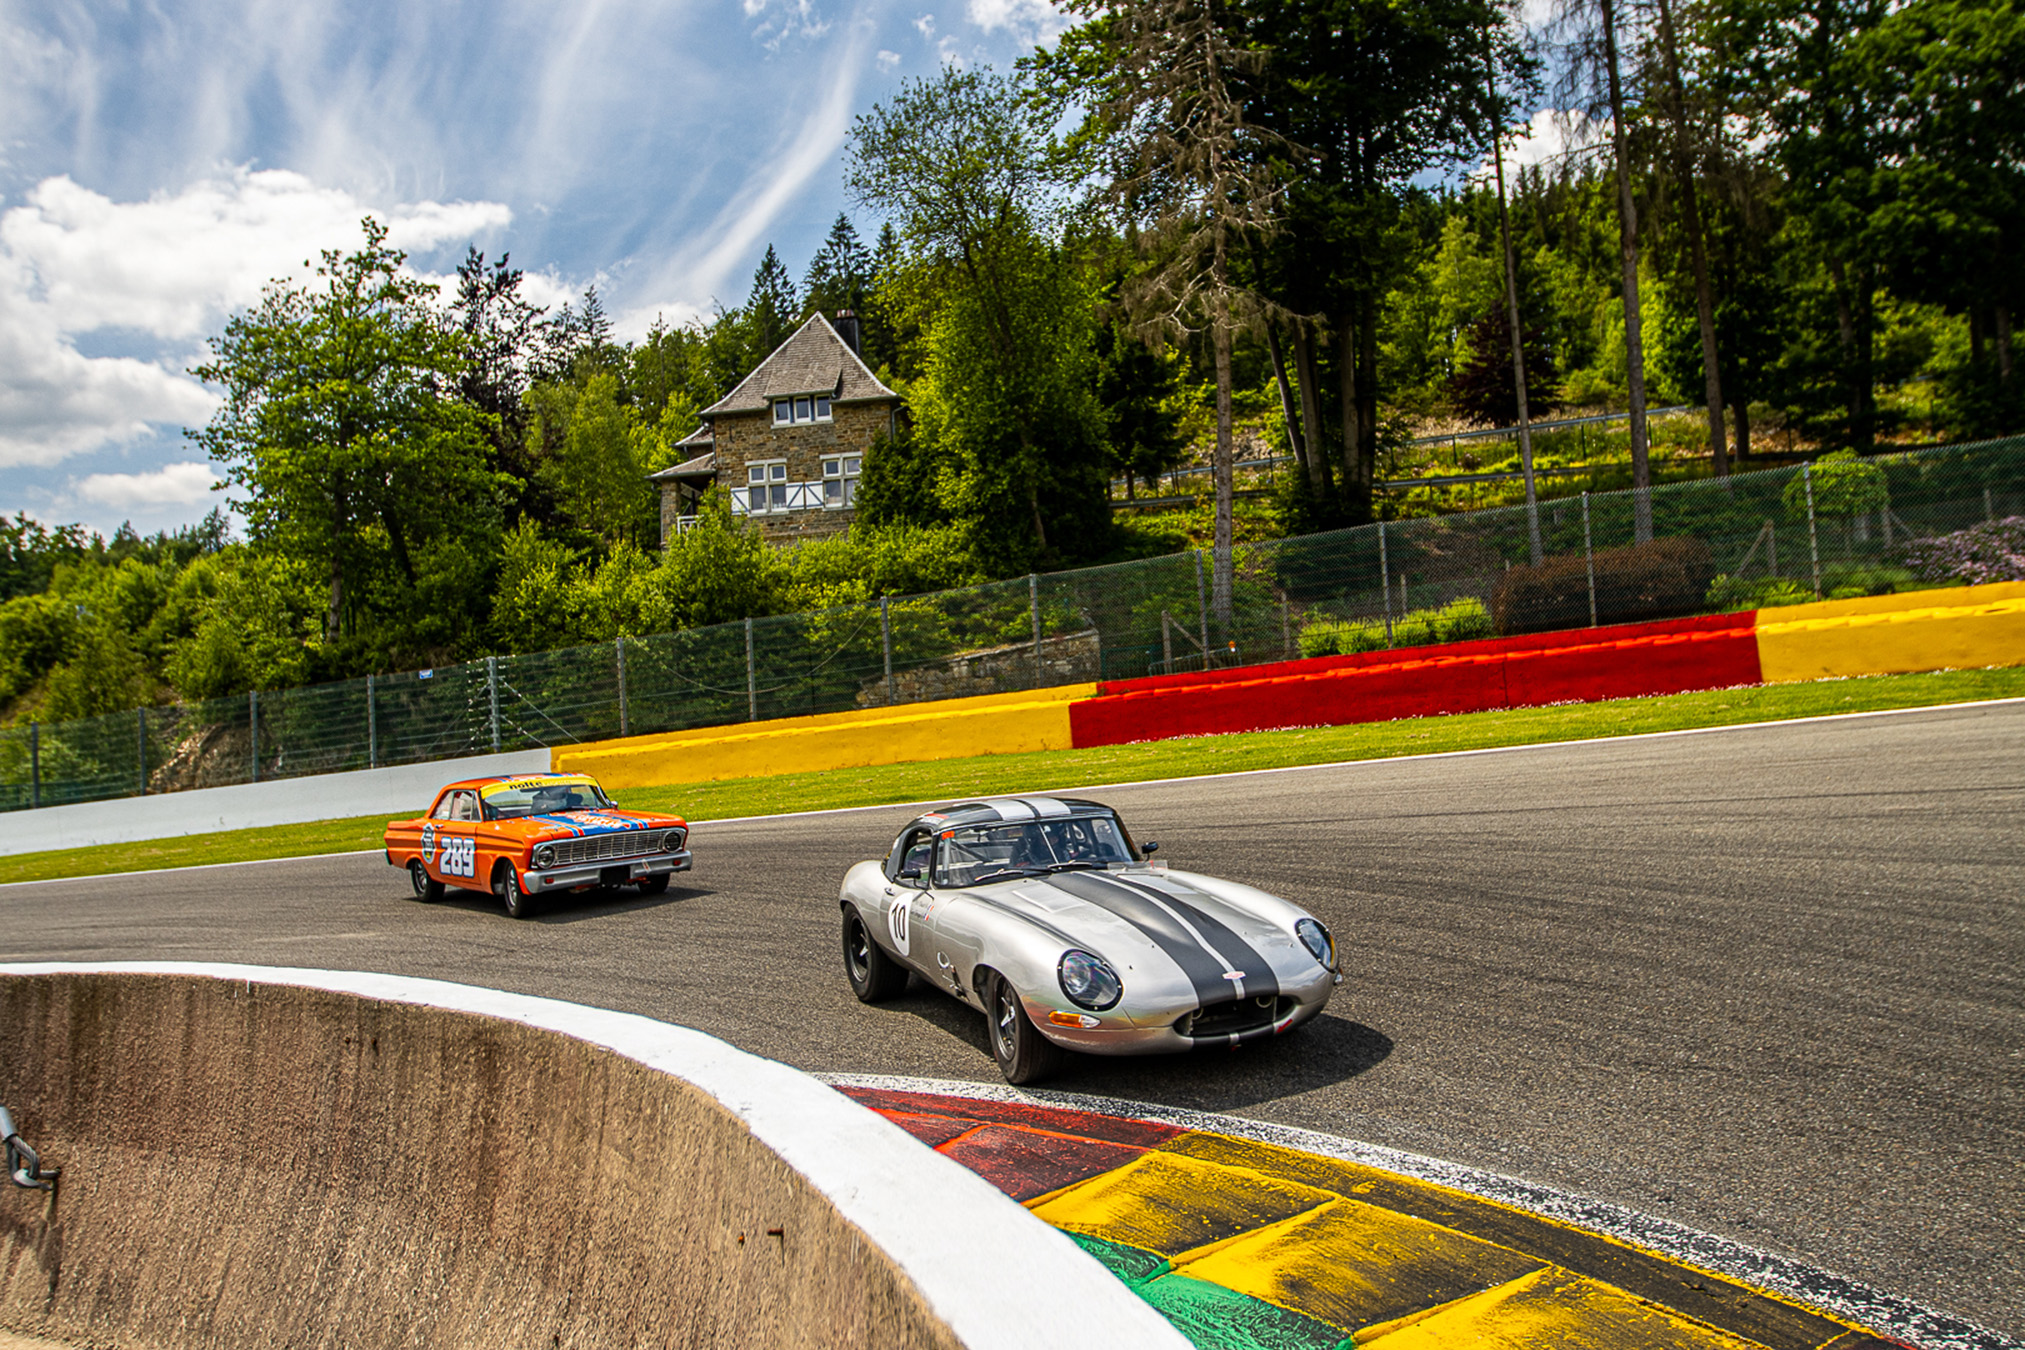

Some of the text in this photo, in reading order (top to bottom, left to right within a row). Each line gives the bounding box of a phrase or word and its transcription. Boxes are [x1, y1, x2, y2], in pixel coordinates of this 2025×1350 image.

[509, 781, 542, 790] nolte
[440, 836, 475, 877] 289
[892, 903, 906, 941] 10
